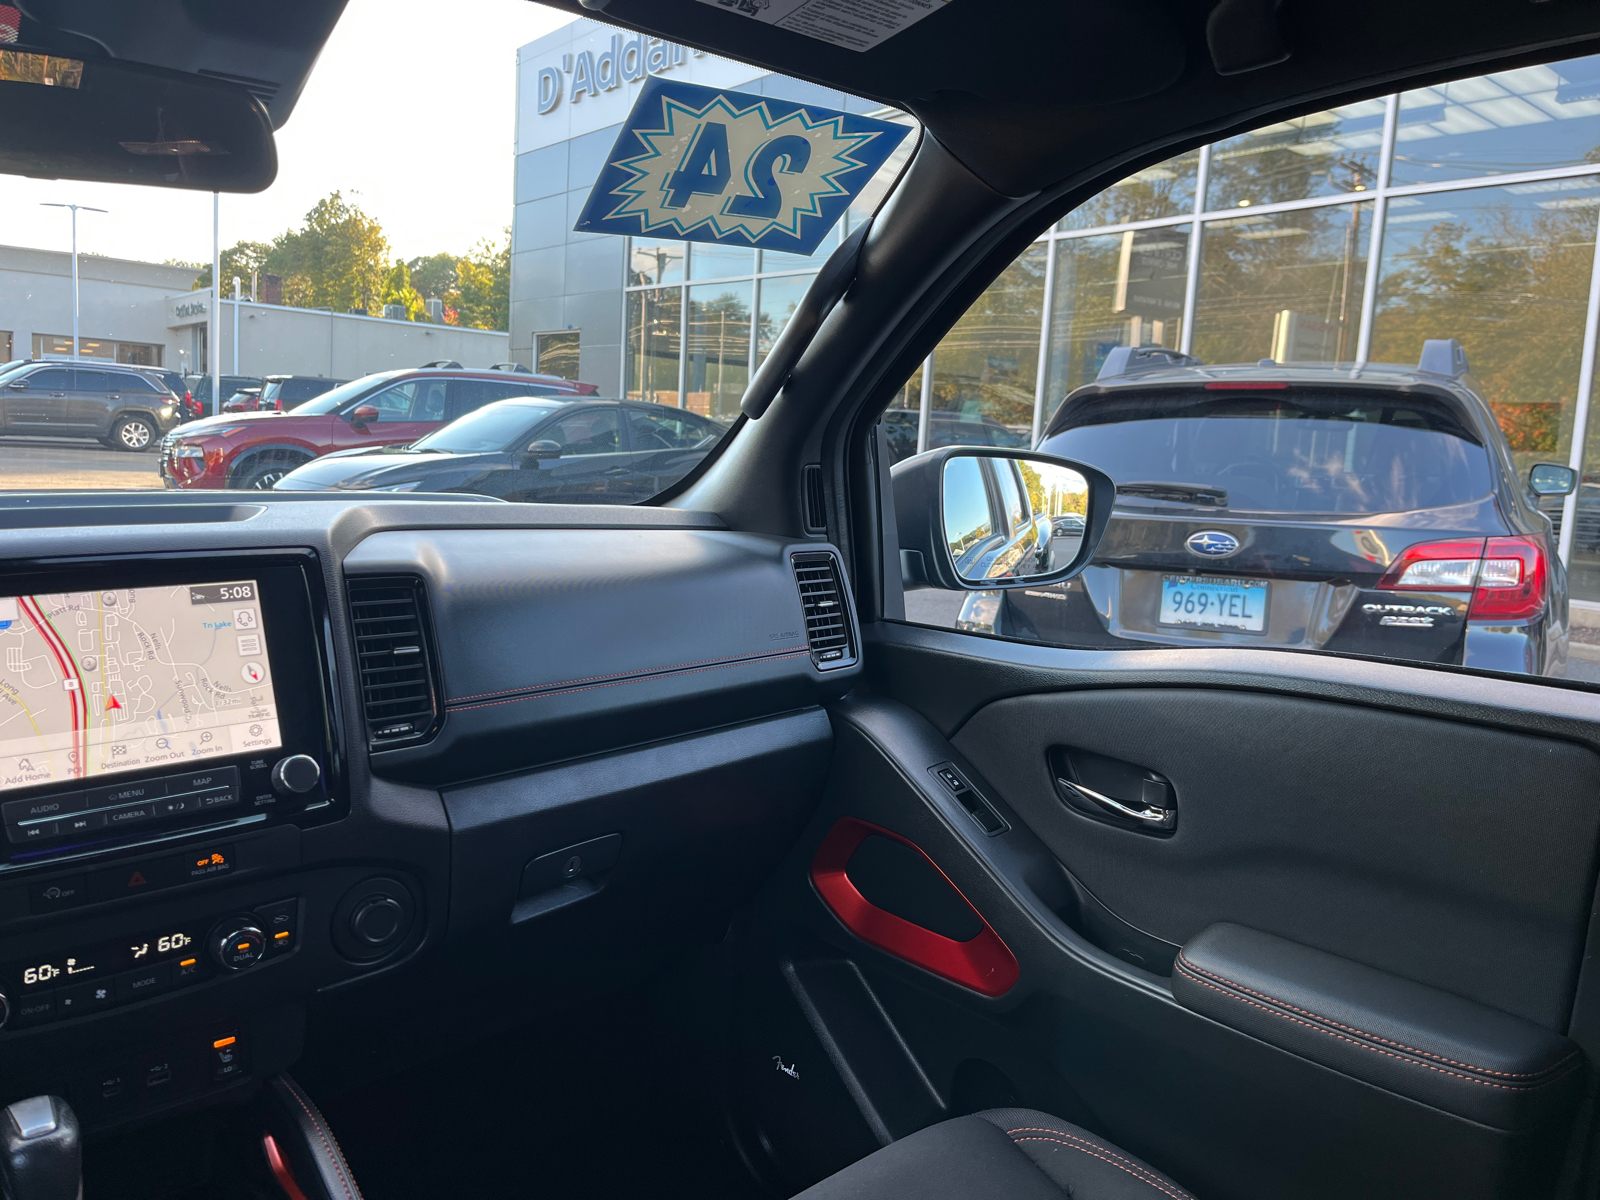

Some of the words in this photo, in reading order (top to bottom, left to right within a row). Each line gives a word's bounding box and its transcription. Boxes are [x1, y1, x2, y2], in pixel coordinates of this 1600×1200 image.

[537, 33, 706, 116] D'Addar
[220, 586, 252, 600] 5:08
[1191, 584, 1239, 593] Connecticut
[47, 607, 66, 619] Platt
[69, 604, 80, 612] Rd
[1363, 603, 1453, 616] OUTBACK
[214, 621, 232, 629] Lake
[137, 632, 151, 650] Rock
[147, 650, 156, 661] Rd
[200, 677, 214, 695] Rock
[214, 691, 226, 700] Rd
[213, 680, 232, 693] Nells
[175, 680, 192, 714] Sunwood
[242, 738, 272, 748] Settings
[144, 754, 168, 763] Zoom
[170, 751, 185, 759] Out
[191, 747, 214, 756] Zoom
[101, 758, 141, 770] Destination
[68, 766, 82, 775] POI
[5, 775, 23, 785] Add
[25, 772, 51, 782] Home
[193, 777, 212, 787] MAP
[118, 789, 145, 799] MENU
[214, 794, 233, 803] BACK
[30, 803, 60, 814] AUDIO
[112, 810, 146, 821] CAMERA
[217, 863, 229, 871] BAG
[233, 951, 254, 962] DUAL
[132, 977, 156, 988] MODE
[772, 1055, 800, 1080] Fender
